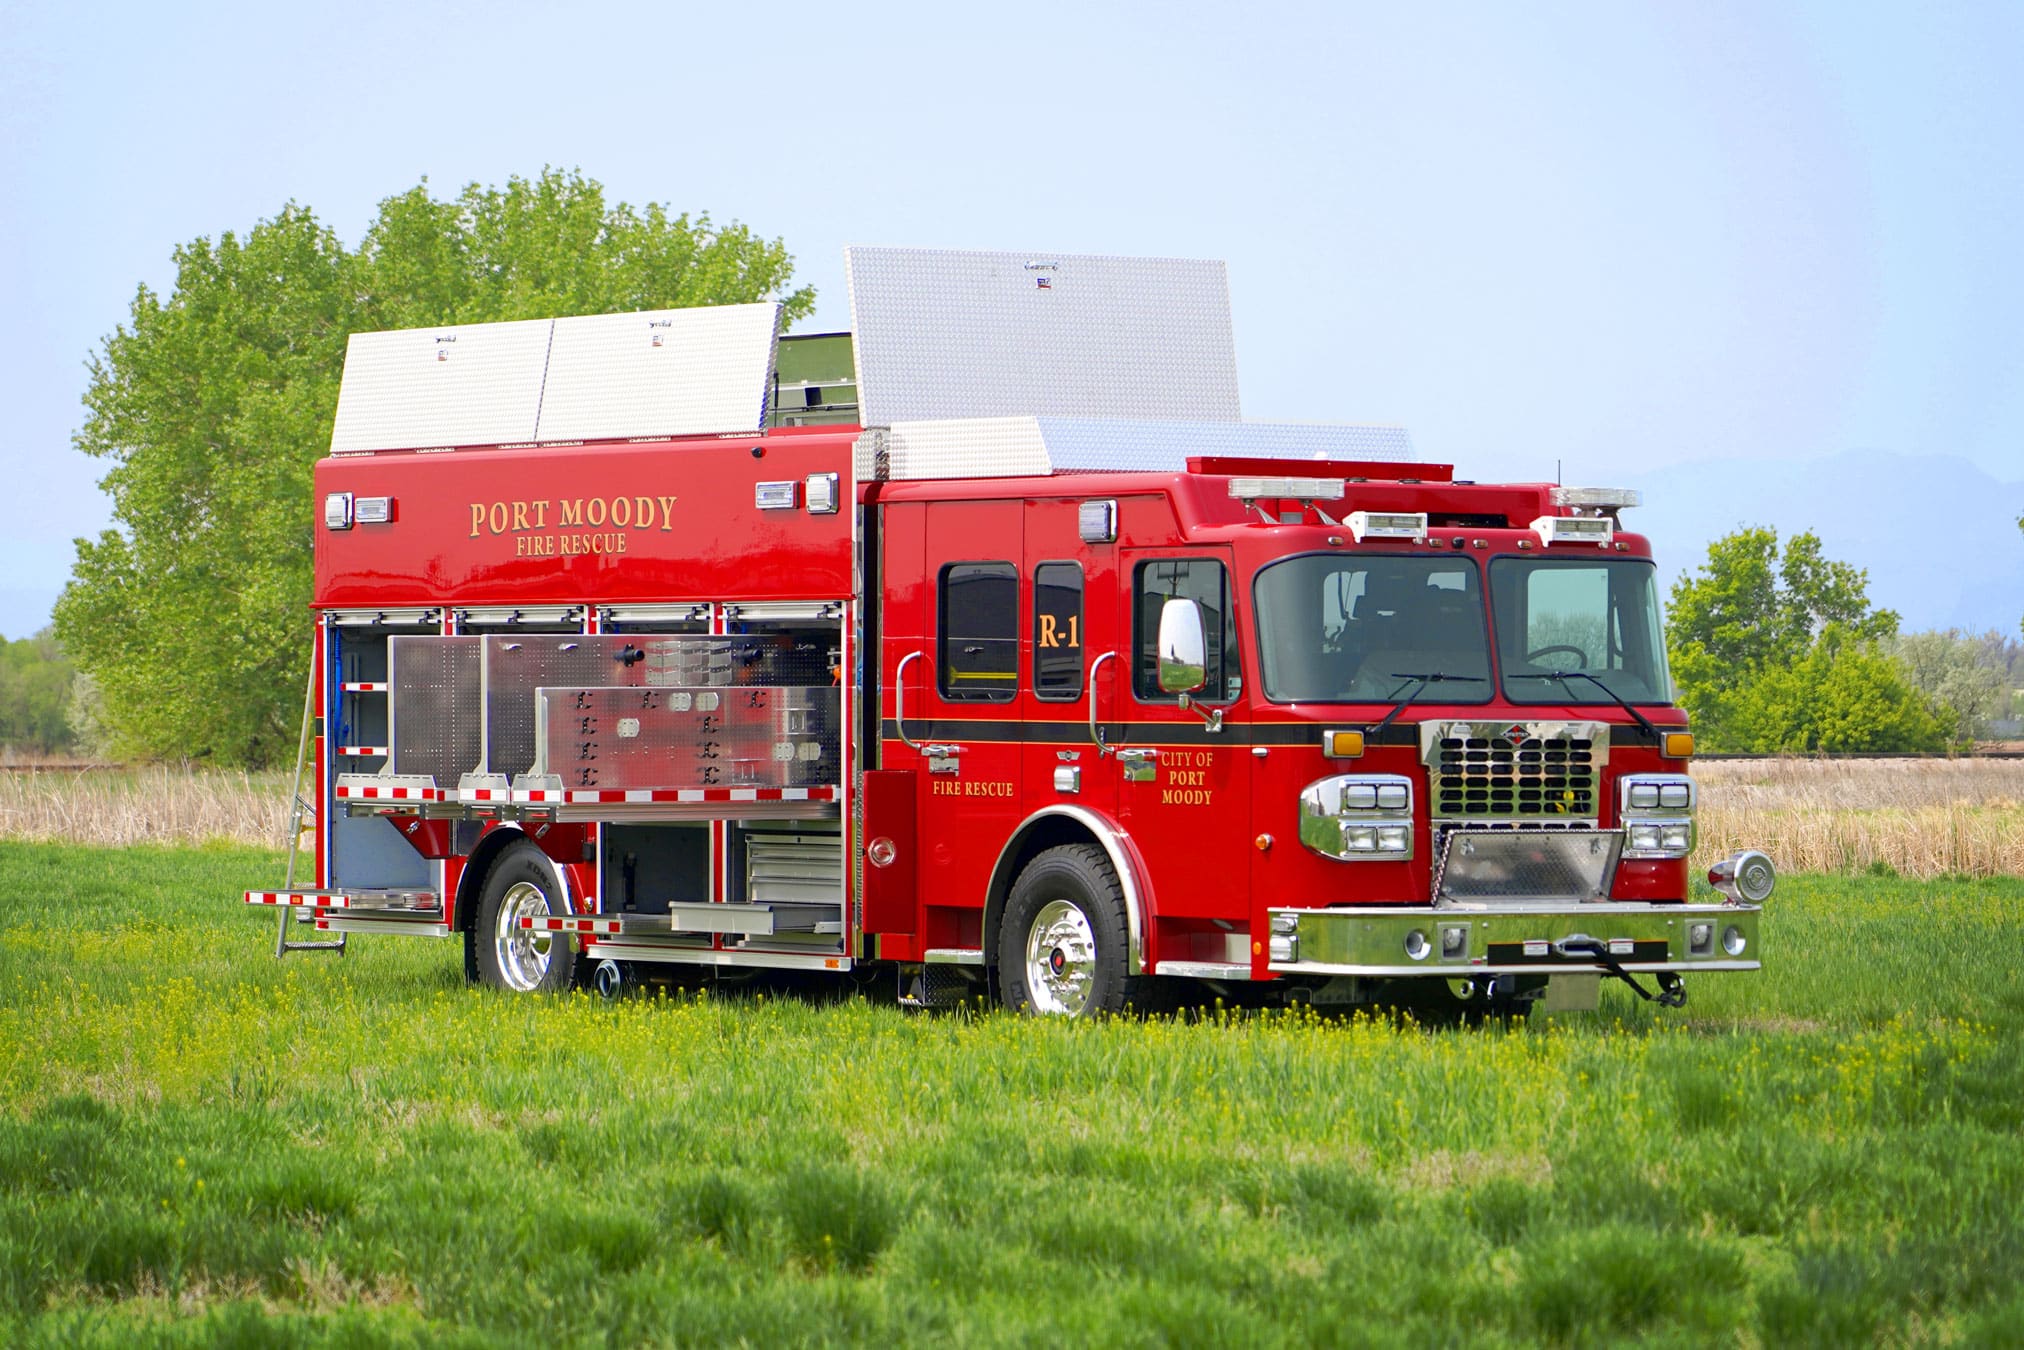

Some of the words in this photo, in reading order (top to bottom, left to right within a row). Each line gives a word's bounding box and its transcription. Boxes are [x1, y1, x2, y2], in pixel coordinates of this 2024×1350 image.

[469, 501, 549, 538] PORT
[559, 496, 678, 531] MOODY
[516, 535, 555, 556] FIRE
[559, 532, 626, 554] RESCUE
[1039, 614, 1080, 648] R-1
[1161, 752, 1192, 767] CITY
[1195, 752, 1214, 767] OF
[1169, 771, 1206, 786] PORT
[932, 781, 961, 796] FIRE
[964, 782, 1014, 797] RESCUE
[1162, 790, 1213, 806] MOODY
